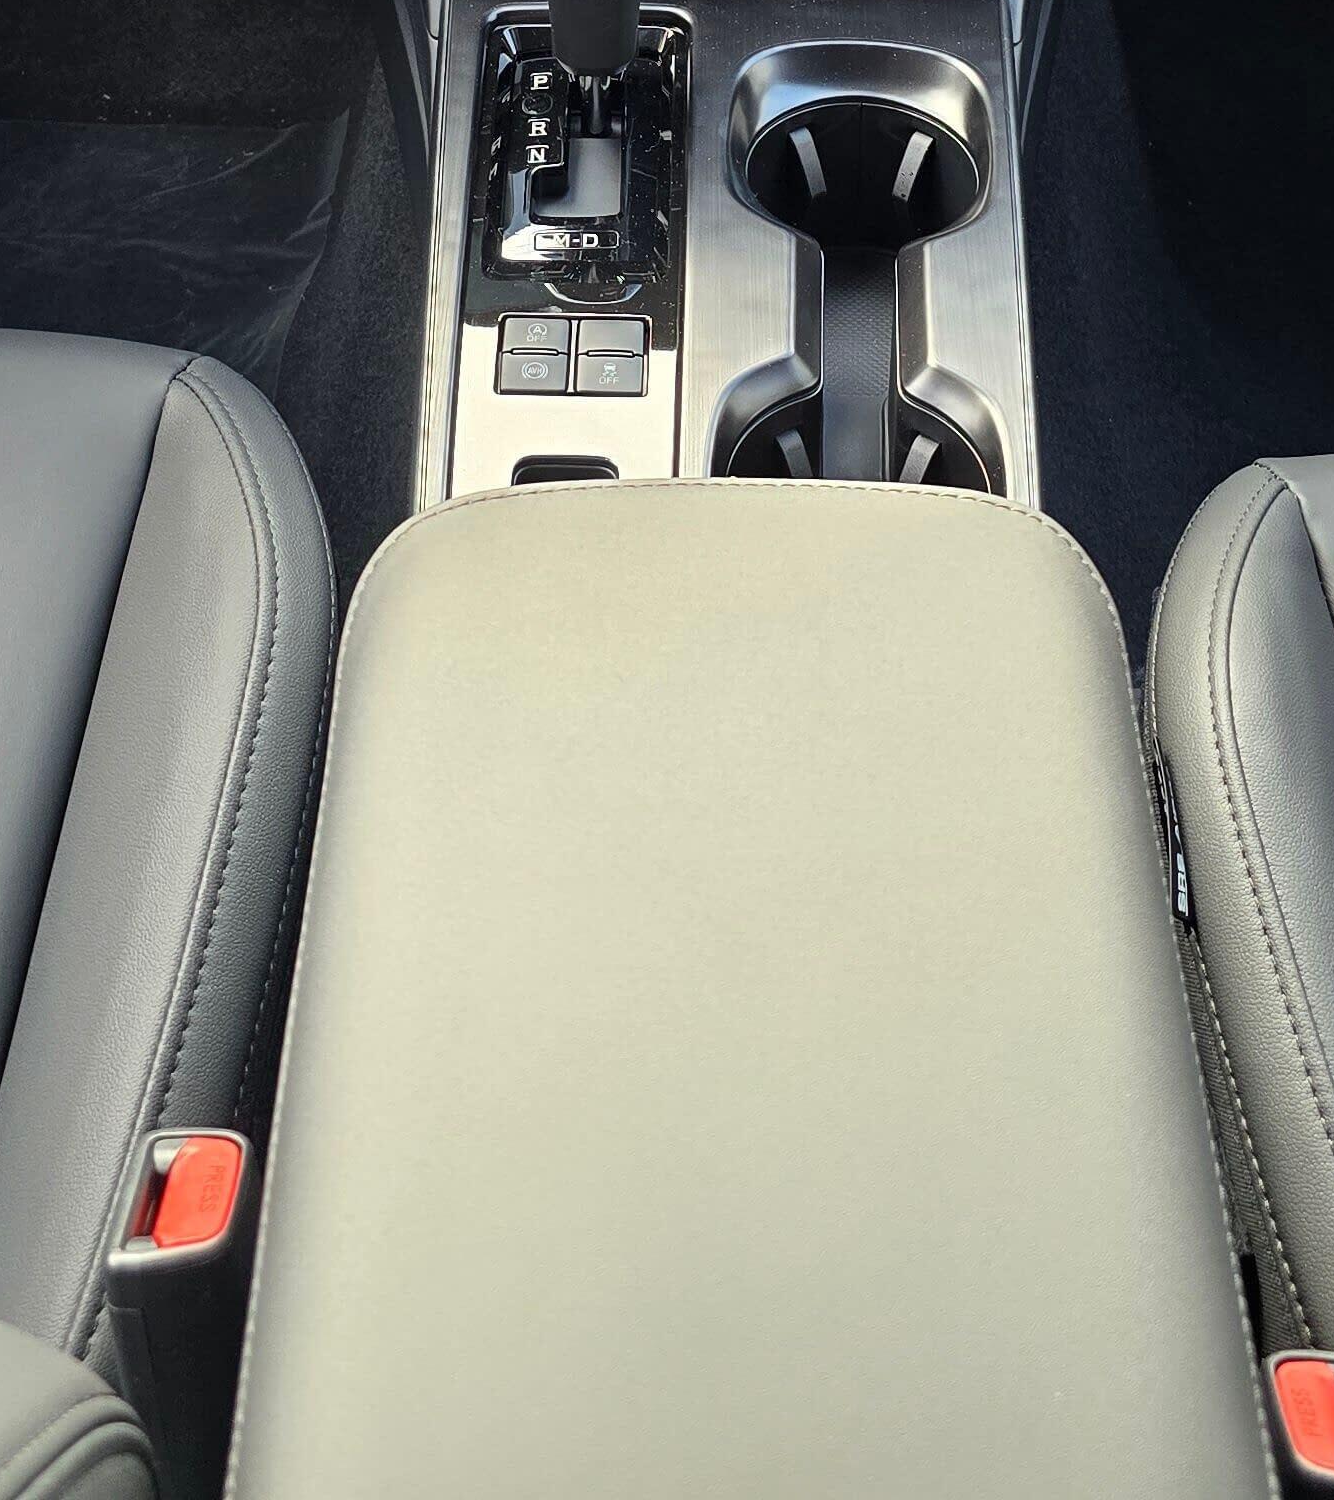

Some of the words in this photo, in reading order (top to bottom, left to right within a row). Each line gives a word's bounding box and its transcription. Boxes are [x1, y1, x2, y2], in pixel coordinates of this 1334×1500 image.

[532, 74, 549, 89] P
[530, 121, 547, 136] R
[529, 148, 546, 162] N
[527, 334, 548, 342] OFF
[599, 376, 619, 385] OFF
[198, 1164, 227, 1214] PRESS
[1291, 1388, 1323, 1438] PRESS
